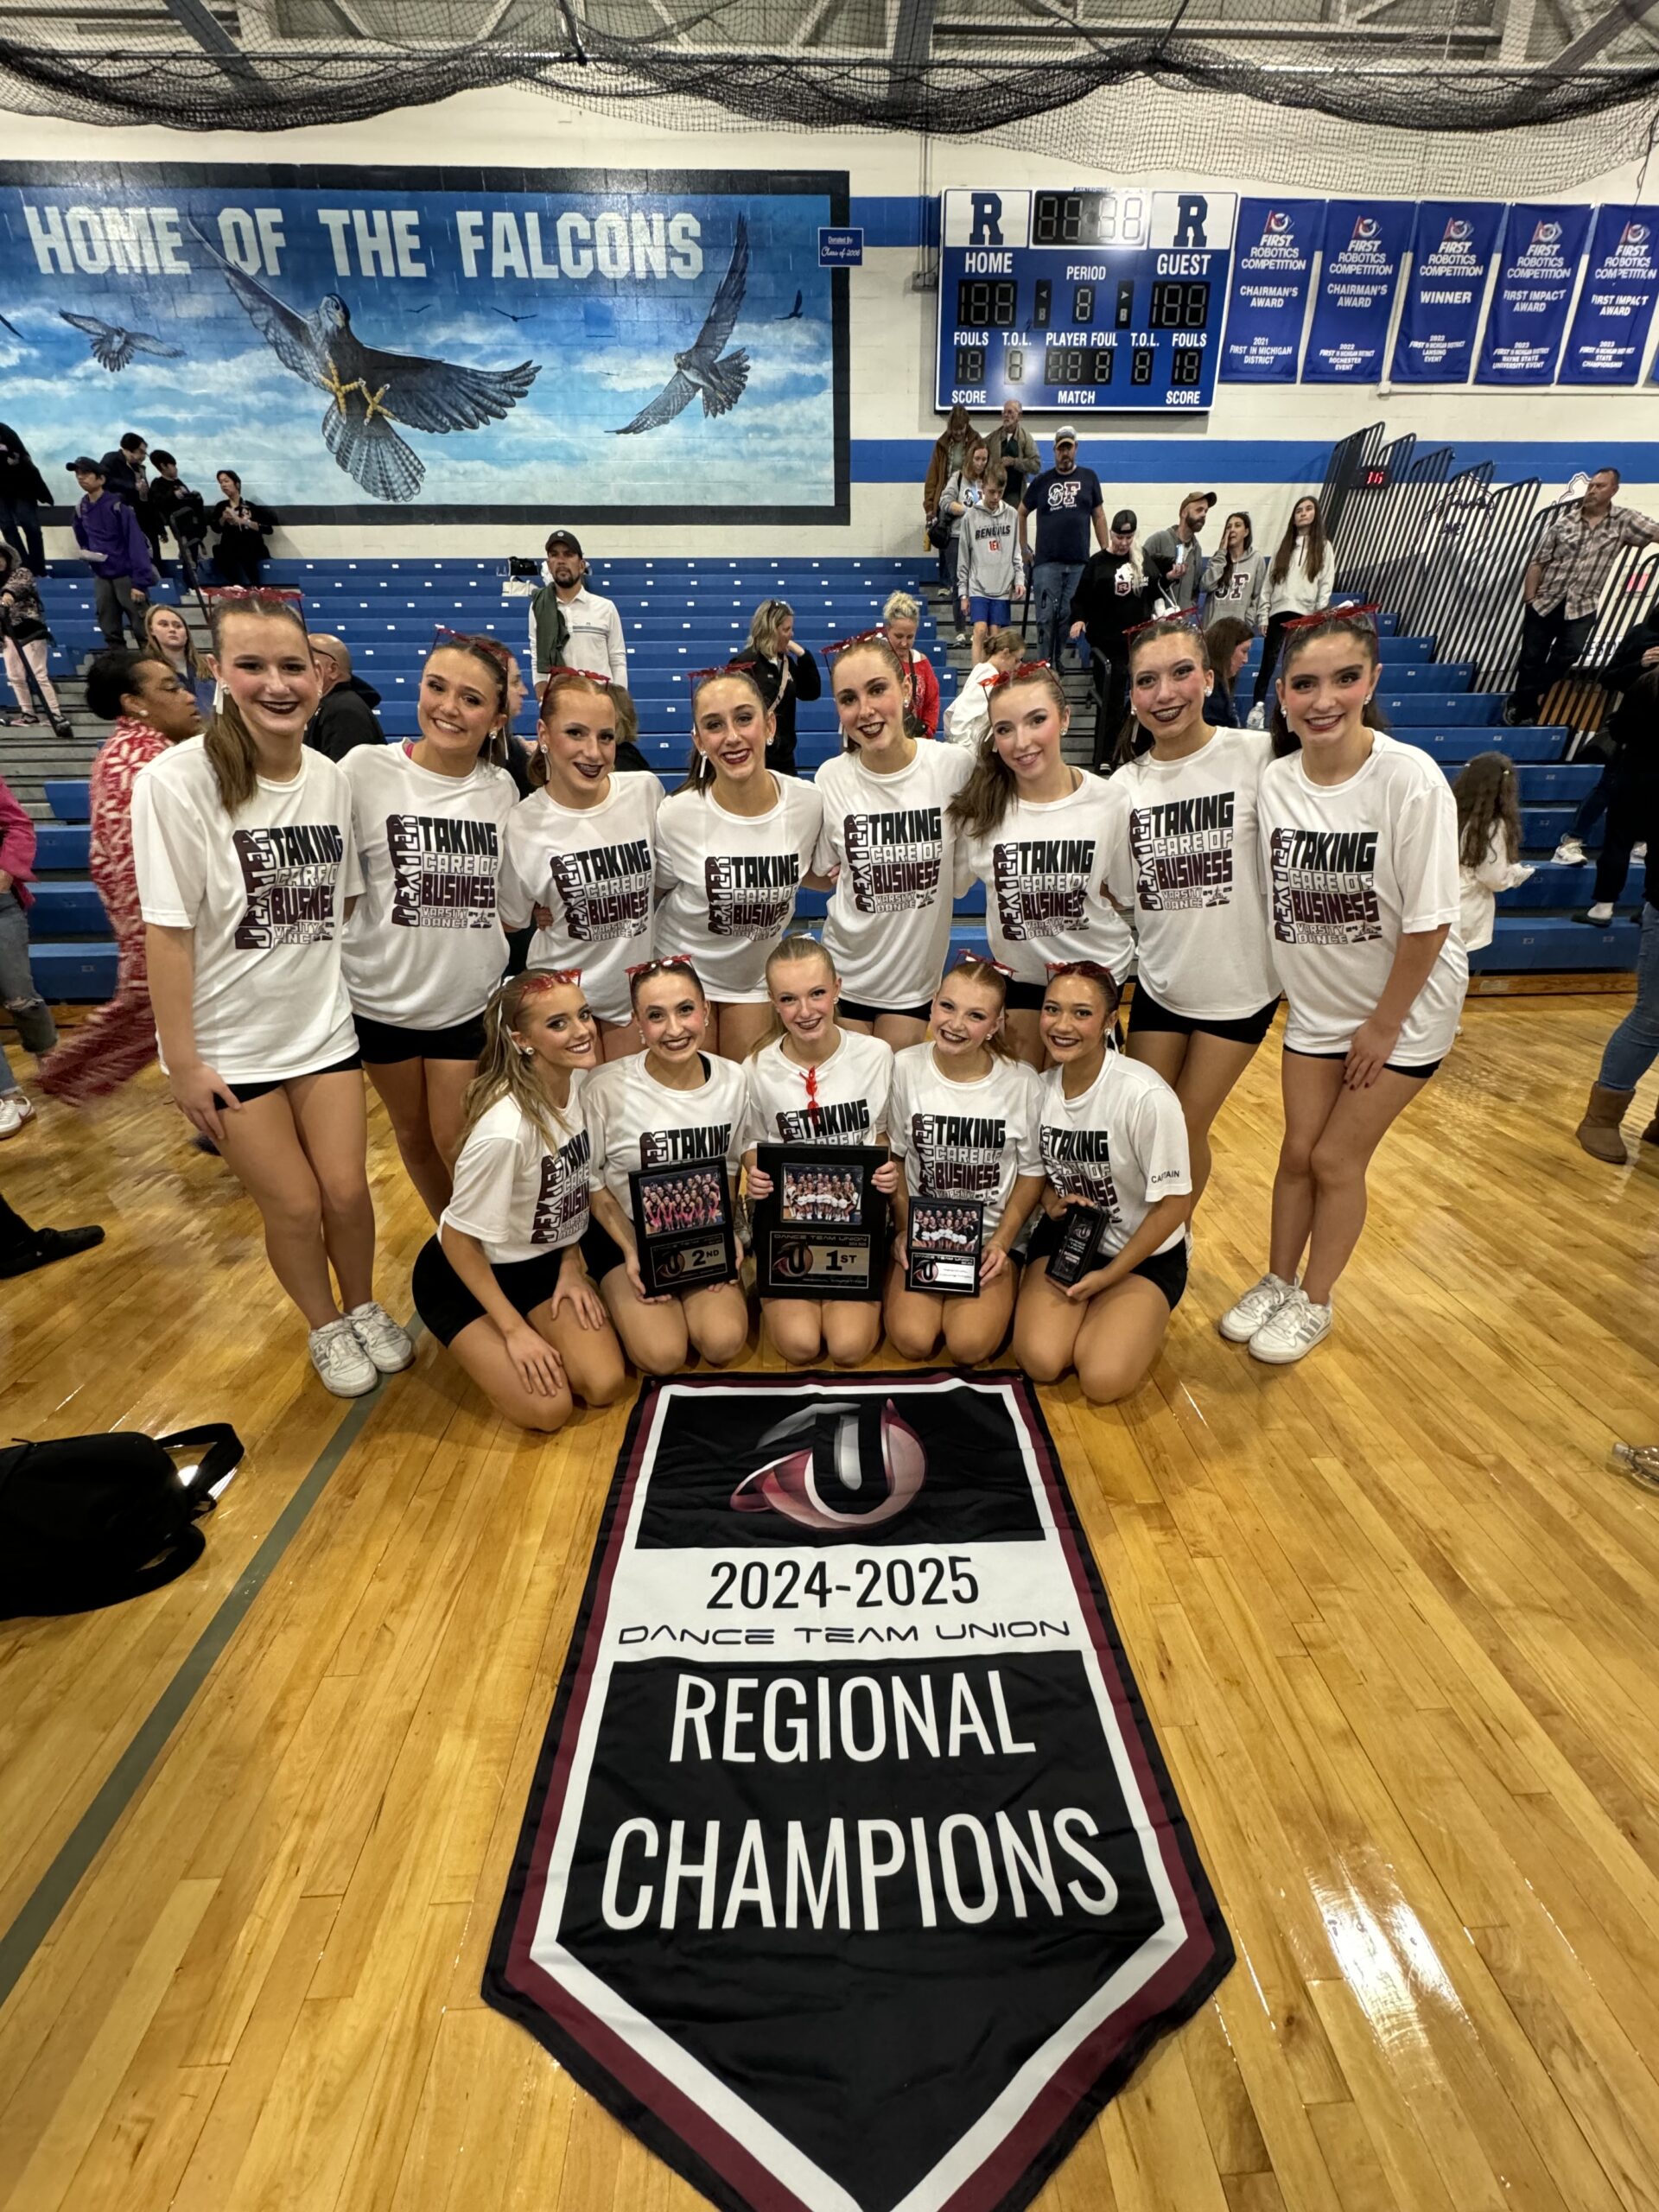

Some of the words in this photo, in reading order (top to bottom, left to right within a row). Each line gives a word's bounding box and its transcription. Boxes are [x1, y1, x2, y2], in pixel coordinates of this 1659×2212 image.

[969, 193, 1004, 245] R
[1173, 195, 1208, 248] R
[24, 207, 191, 275] HOME
[217, 207, 286, 276] OF
[317, 209, 427, 277] THE
[456, 211, 703, 279] FALCONS
[1260, 235, 1294, 246] FIRST
[1348, 240, 1382, 251] FIRST
[1438, 242, 1472, 253] FIRST
[1250, 247, 1299, 258] ROBOTICS
[1338, 252, 1386, 264] ROBOTICS
[1526, 245, 1560, 257] FIRST
[1615, 245, 1649, 257] FIRST
[965, 252, 1013, 273] HOME
[1157, 254, 1211, 275] GUEST
[1242, 258, 1306, 270] COMPETITION
[1428, 255, 1476, 265] ROBOTICS
[1516, 257, 1564, 267] ROBOTICS
[1604, 257, 1651, 268] ROBOTICS
[1066, 265, 1106, 280] PERIOD
[1329, 264, 1393, 275] COMPETITION
[1420, 265, 1484, 276] COMPETITION
[1507, 268, 1571, 279] COMPETITION
[1240, 286, 1299, 297] CHAIRMAN'S
[1327, 283, 1388, 296] CHAIRMAN'S
[1503, 290, 1527, 300] FIRST
[1529, 289, 1567, 301] IMPACT
[1250, 298, 1285, 308] AWARD
[1337, 297, 1372, 308] AWARD
[1421, 291, 1472, 303] WINNER
[1592, 295, 1615, 304] FIRST
[1616, 296, 1649, 306] IMPACT
[1514, 302, 1546, 312] AWARD
[1599, 306, 1631, 316] AWARD
[954, 332, 989, 346] FOULS
[1002, 332, 1032, 346] T.O.L.
[1046, 332, 1087, 346] PLAYER
[1090, 332, 1118, 346] FOUL
[1131, 333, 1160, 347] T.O.L.
[1172, 333, 1207, 347] FOULS
[1253, 337, 1268, 346] 2021
[1230, 345, 1246, 354] FIRST
[1258, 346, 1292, 355] MICHIGAN
[1243, 356, 1274, 365] DISTRICT
[951, 391, 987, 404] SCORE
[1058, 391, 1096, 404] MATCH
[1166, 391, 1200, 404] SCORE
[1151, 791, 1235, 837] TAKING
[868, 807, 942, 846] TAKING
[417, 817, 499, 855] TAKING
[1153, 831, 1205, 858] CARE
[1208, 828, 1234, 851] OF
[270, 825, 343, 868] TAKING
[870, 842, 918, 864] CARE
[923, 841, 943, 862] OF
[1291, 830, 1379, 872] TAKING
[422, 852, 474, 875] CARE
[479, 853, 498, 876] OF
[576, 839, 652, 883] TAKING
[1018, 840, 1096, 874] TAKING
[277, 865, 327, 887] CARE
[731, 853, 798, 888] TAKING
[1155, 849, 1233, 890] BUSINESS
[871, 859, 941, 895] BUSINESS
[1020, 874, 1068, 893] CARE
[1070, 874, 1090, 893] OF
[1288, 868, 1339, 893] CARE
[1342, 873, 1374, 893] OF
[422, 874, 496, 908] BUSINESS
[584, 875, 631, 899] CARE
[1162, 887, 1203, 899] VARSITY
[734, 888, 779, 904] CARE
[874, 892, 917, 904] VARSITY
[875, 899, 916, 912] DANCE
[1163, 898, 1203, 911] DANCE
[1291, 889, 1380, 924] BUSINESS
[421, 907, 468, 918] VARSITY
[421, 918, 468, 929] DANCE
[1025, 917, 1065, 931] VARSITY
[1296, 922, 1344, 935] VARSITY
[1026, 925, 1064, 940] DANCE
[1296, 933, 1349, 944] DANCE
[798, 1099, 869, 1139] TAKING
[935, 1116, 1006, 1148] TAKING
[667, 1123, 731, 1160] TAKING
[935, 1146, 979, 1164] CARE
[983, 1148, 1003, 1164] OF
[935, 1162, 1001, 1191] BUSINESS
[691, 1249, 719, 1267] 2ND
[826, 1249, 857, 1271] 1ST
[706, 1555, 980, 1610] 2024-2025
[619, 1624, 774, 1644] DANCE
[794, 1625, 919, 1644] TEAM
[936, 1620, 1071, 1640] UNION
[669, 1670, 1036, 1764] REGIONAL
[601, 1808, 1119, 1931] CHAMPIONS
